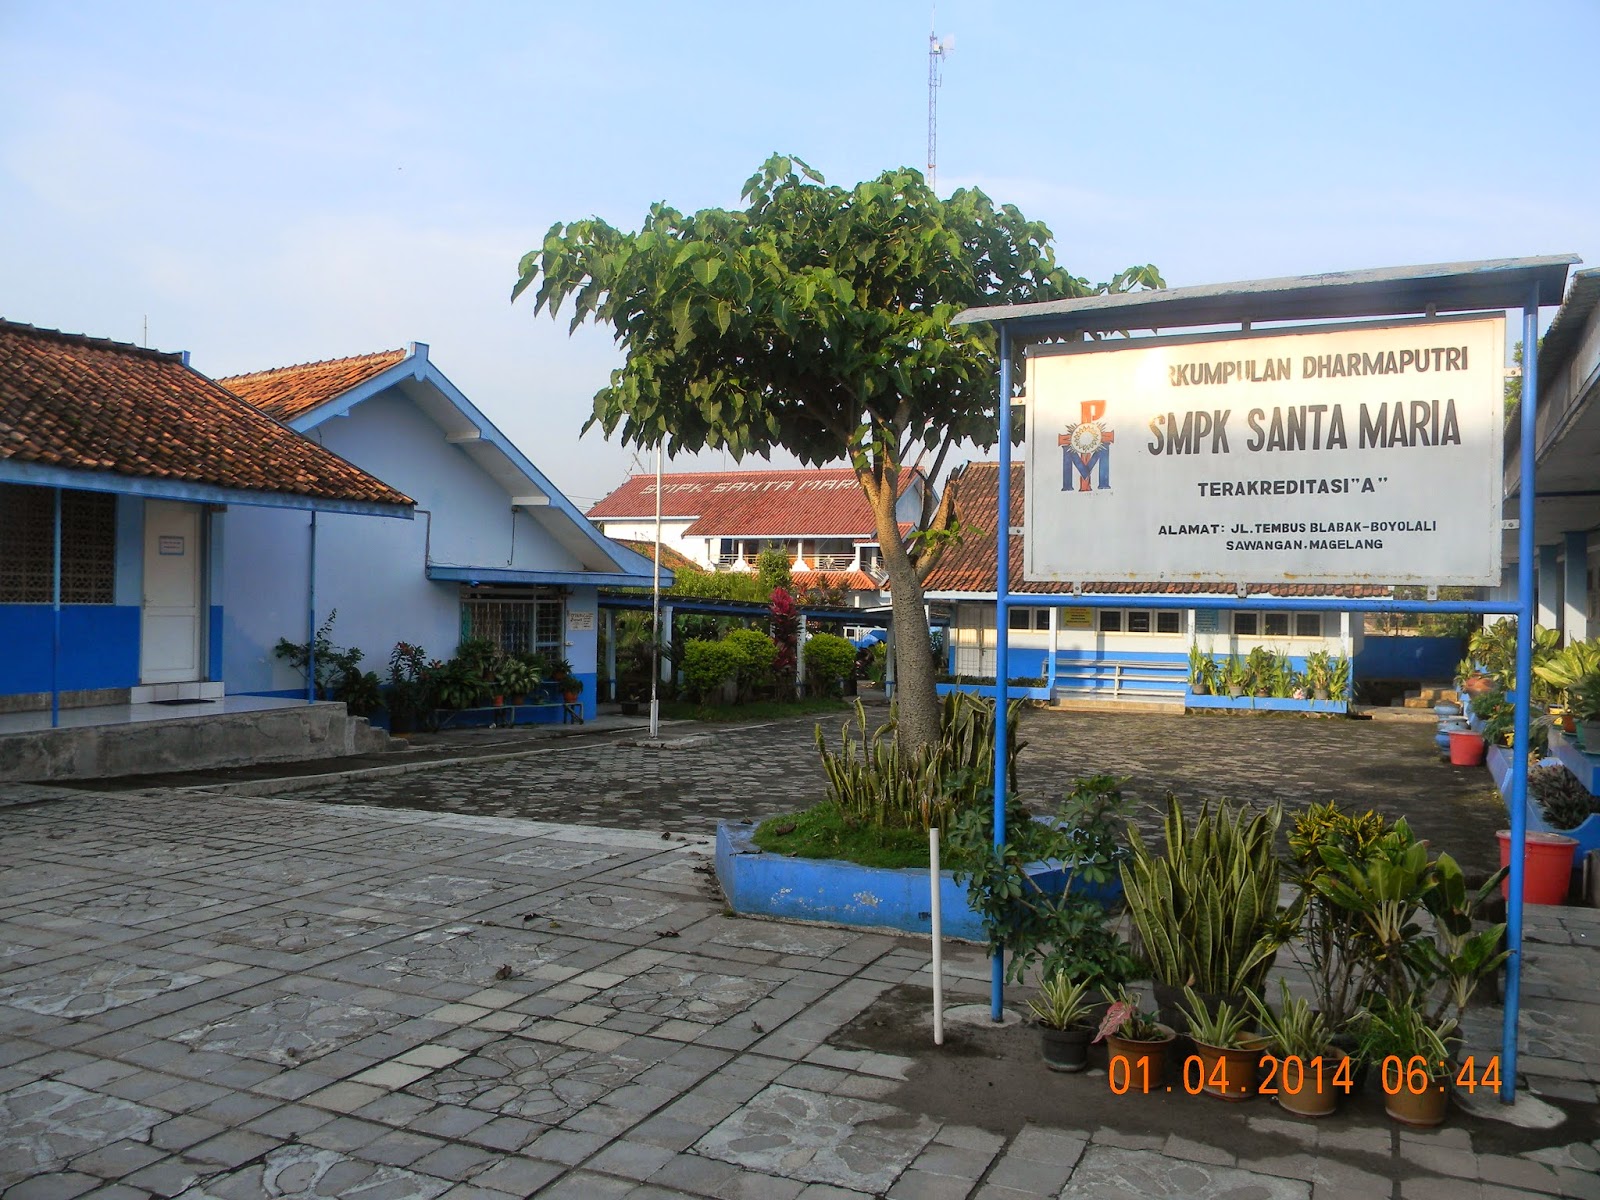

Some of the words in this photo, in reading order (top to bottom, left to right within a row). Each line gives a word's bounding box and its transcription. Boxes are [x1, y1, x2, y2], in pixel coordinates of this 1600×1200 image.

[1302, 346, 1468, 379] DHARMAPUTRI
[1147, 409, 1231, 456] SMPK
[1246, 404, 1348, 452] SANTA
[1359, 399, 1461, 449] MARIA
[710, 481, 795, 493] SANTA
[798, 479, 864, 491] MARI
